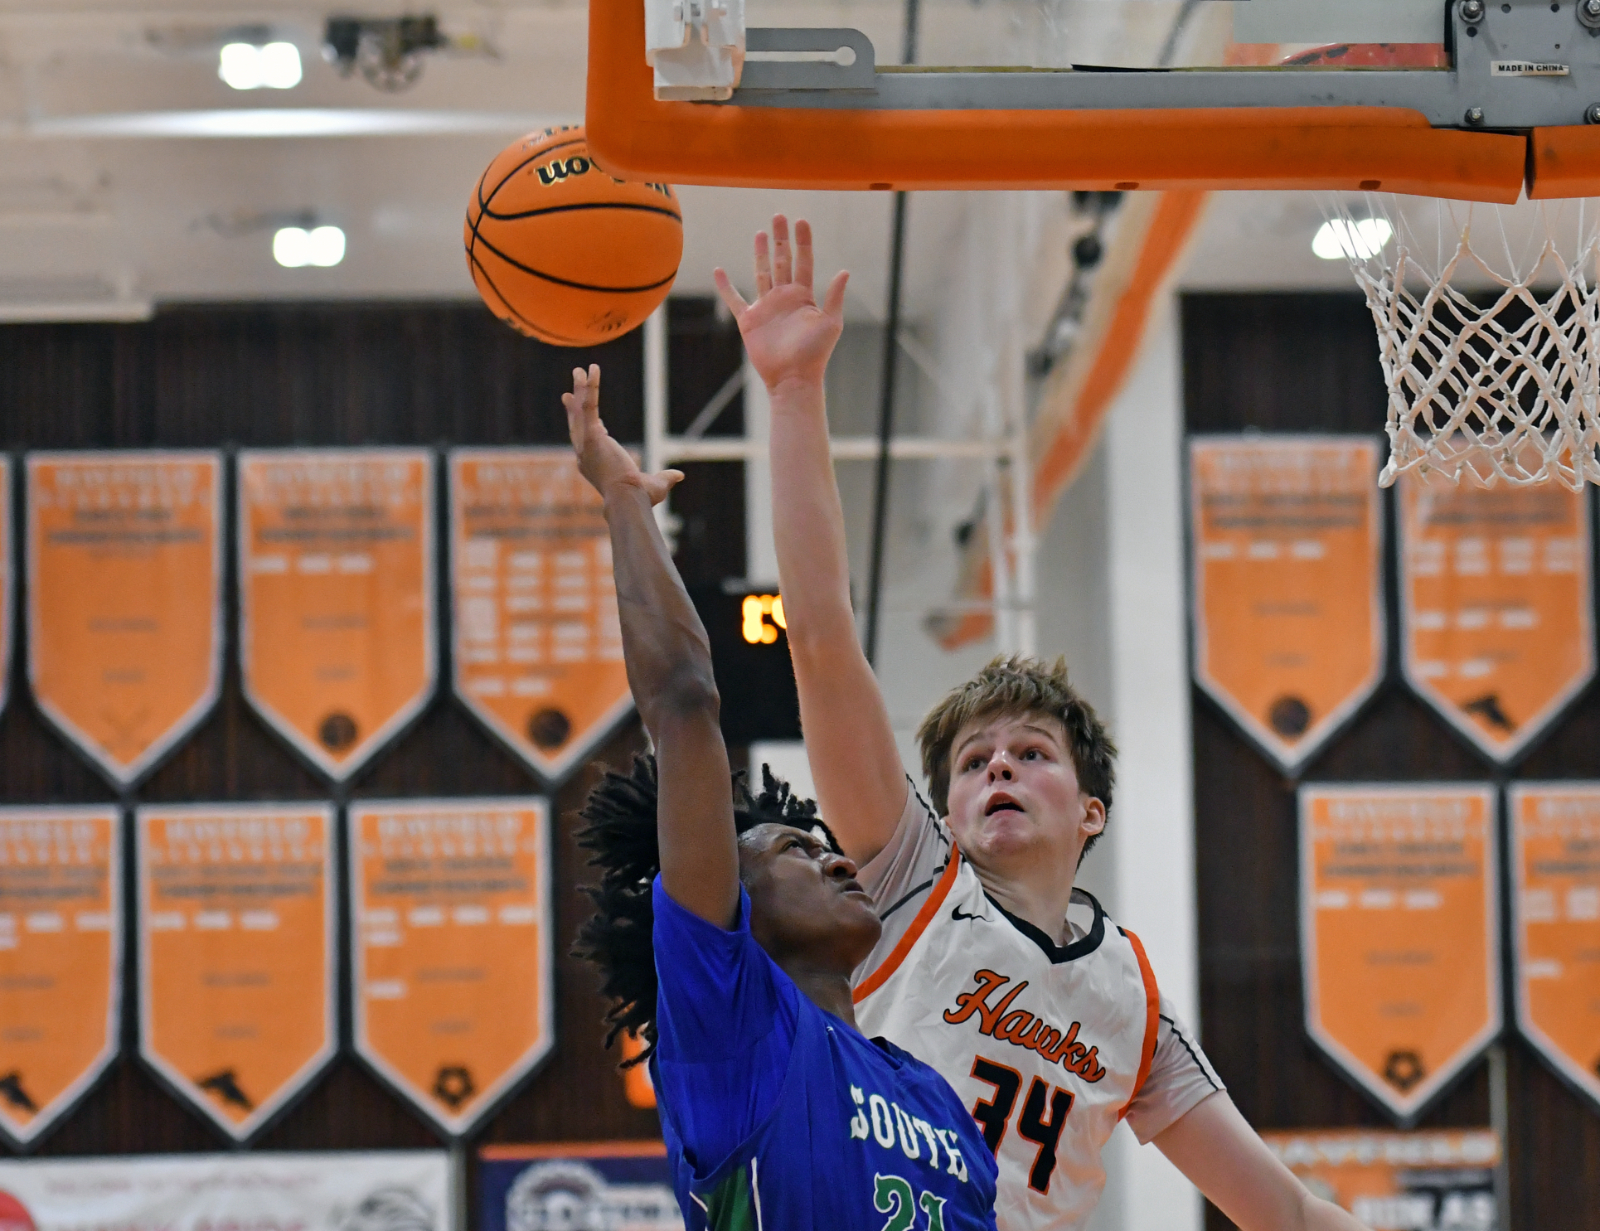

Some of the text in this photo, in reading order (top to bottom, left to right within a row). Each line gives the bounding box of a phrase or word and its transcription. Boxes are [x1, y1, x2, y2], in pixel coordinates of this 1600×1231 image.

[943, 969, 1106, 1083] Hawks
[850, 1083, 969, 1183] SOUTH
[969, 1054, 1076, 1196] 34
